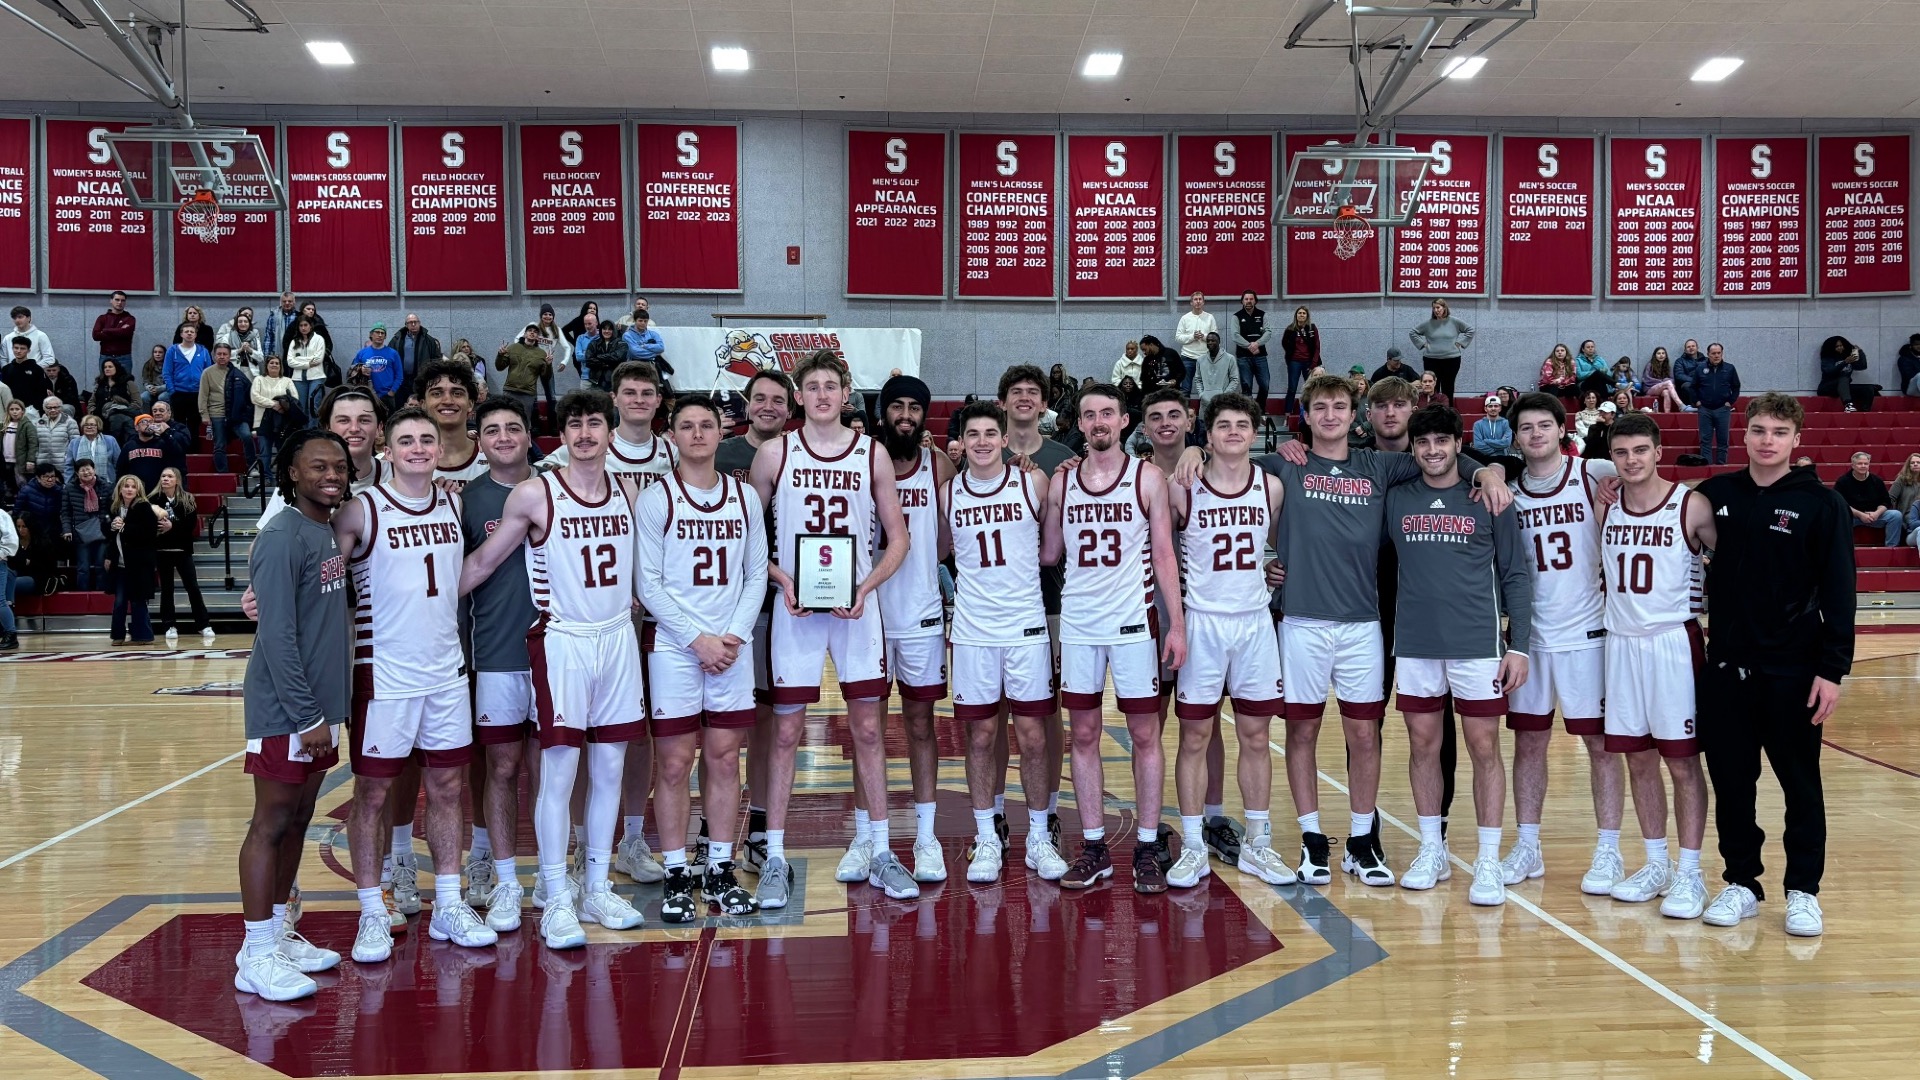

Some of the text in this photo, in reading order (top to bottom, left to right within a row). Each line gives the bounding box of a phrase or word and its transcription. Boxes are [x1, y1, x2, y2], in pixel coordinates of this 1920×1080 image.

[87, 127, 113, 165] S
[326, 131, 350, 169] S
[442, 131, 465, 169] S
[559, 130, 584, 167] S
[676, 130, 700, 167] S
[885, 137, 907, 174] S
[996, 140, 1018, 176] S
[1105, 141, 1127, 177] S
[1214, 141, 1236, 177] S
[1430, 140, 1452, 175] S
[1538, 143, 1559, 178] S
[1645, 144, 1666, 179] S
[1751, 144, 1772, 179] S
[1854, 142, 1875, 177] S
[53, 168, 147, 180] WOMEN'S BASKEBALL
[78, 181, 122, 194] NCAA
[180, 184, 268, 196] CORENCE
[412, 185, 496, 195] CONFERENCE
[552, 184, 594, 196] NCAA
[646, 183, 730, 195] CONFERENCE
[1439, 180, 1471, 188] SOCCER
[318, 185, 361, 198] NCAA
[876, 190, 916, 203] NCAA
[967, 192, 1047, 203] CONFERENCE
[56, 195, 131, 207] APPEARANC
[412, 198, 496, 208] CHAMPIONS
[531, 198, 616, 207] APPEARANCES
[647, 196, 730, 207] CHAMPIONS
[1095, 193, 1135, 205] NCAA
[1186, 193, 1265, 203] CONFERENCE
[1510, 194, 1587, 204] CONFERENCE
[1637, 195, 1674, 206] NCAA
[1722, 194, 1799, 204] CONFERENCE
[1845, 193, 1883, 204] NCAA
[297, 200, 383, 209] APPEARANCES
[855, 204, 936, 214] APPEARANCES
[967, 205, 1047, 216] CHAMPIONS
[1186, 205, 1265, 216] CHAMPIONS
[1401, 203, 1480, 215] CAMPIONS
[1826, 205, 1904, 216] APPEARANCES
[56, 210, 143, 220] 2009 2011 2015
[648, 211, 730, 221] 2021 2022 2023
[1076, 207, 1156, 216] APPEARANCES
[1510, 205, 1587, 217] CHAMPIONS
[1618, 208, 1694, 217] APPEARANCES
[1722, 206, 1799, 217] CHAMPIONS
[244, 214, 267, 223] 2001
[299, 214, 320, 222] 2016
[412, 213, 495, 222] 2008 2009 2010
[533, 226, 554, 234] 2015
[968, 220, 989, 228] 1989
[1025, 221, 1045, 229] 2001
[1186, 221, 1265, 229] 2003 2004 2005
[1751, 221, 1771, 229] 1987
[1779, 221, 1798, 229] 1993
[1076, 233, 1155, 242] 2004 2005 2006
[1294, 231, 1316, 240] 2018
[1510, 233, 1530, 241] 2022
[1400, 243, 1478, 252] 2004 2005 2006
[1827, 269, 1846, 277] 2021
[1645, 282, 1665, 290] 2021
[1672, 282, 1693, 290] 2022
[769, 333, 841, 351] STEVENS
[793, 468, 861, 491] STEVENS
[1303, 474, 1371, 497] STEVENS
[1305, 491, 1369, 505] BASKETBALL
[804, 494, 849, 535] 32
[955, 502, 1023, 528] STEVENS
[1067, 502, 1133, 524] STEVENS
[1197, 506, 1264, 529] STEVENS
[1517, 503, 1585, 530] STEVENS
[560, 514, 629, 539] STEVENS
[676, 519, 743, 540] STEVENS
[1402, 515, 1476, 536] STEVENS
[387, 522, 459, 549] STEVENS
[1406, 534, 1469, 544] BASKETBALL
[1605, 525, 1673, 547] STEVENS
[976, 529, 1007, 568] 11
[1078, 529, 1122, 568] 23
[1212, 532, 1257, 572] 22
[1533, 531, 1573, 572] 13
[819, 544, 832, 567] S
[581, 543, 618, 588] 12
[693, 546, 729, 586] 21
[424, 553, 438, 598] 1
[1617, 553, 1654, 595] 10
[1492, 678, 1500, 694] S
[1684, 719, 1694, 735] S
